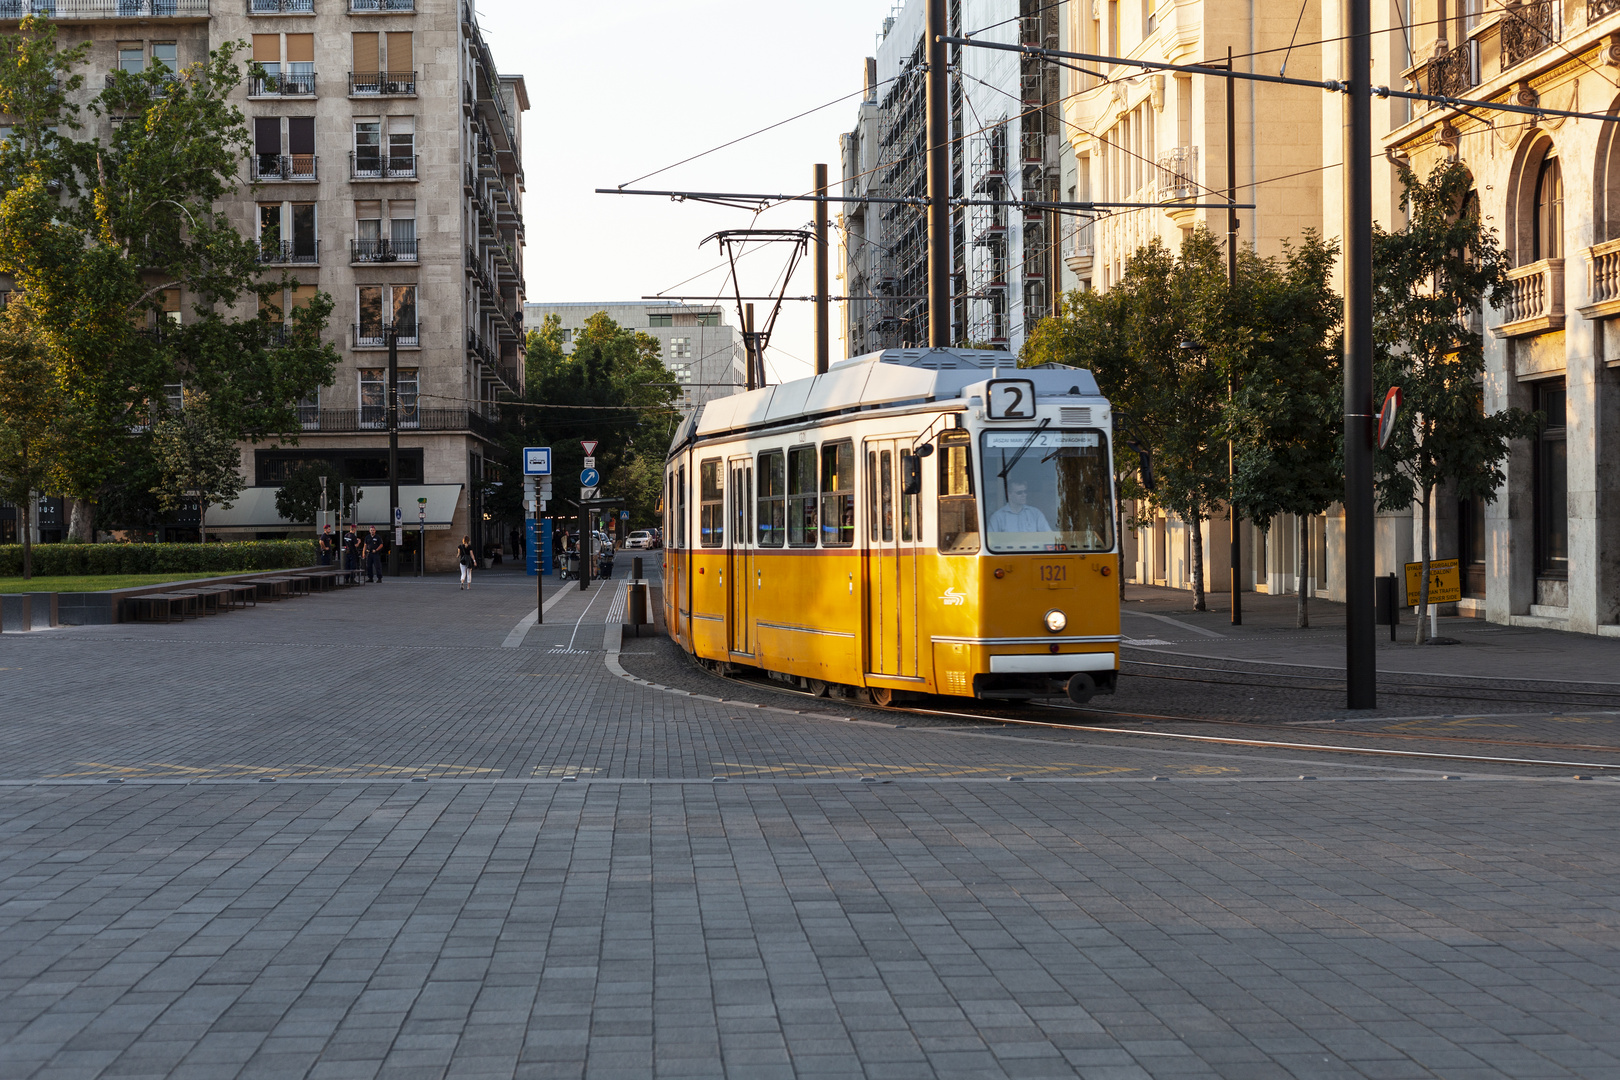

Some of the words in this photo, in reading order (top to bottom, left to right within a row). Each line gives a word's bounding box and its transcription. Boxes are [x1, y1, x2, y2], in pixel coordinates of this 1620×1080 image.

[1004, 387, 1024, 416] 2
[1040, 435, 1048, 446] 2
[1407, 562, 1458, 570] GYALOFORGALOM
[1040, 565, 1066, 581] 1321
